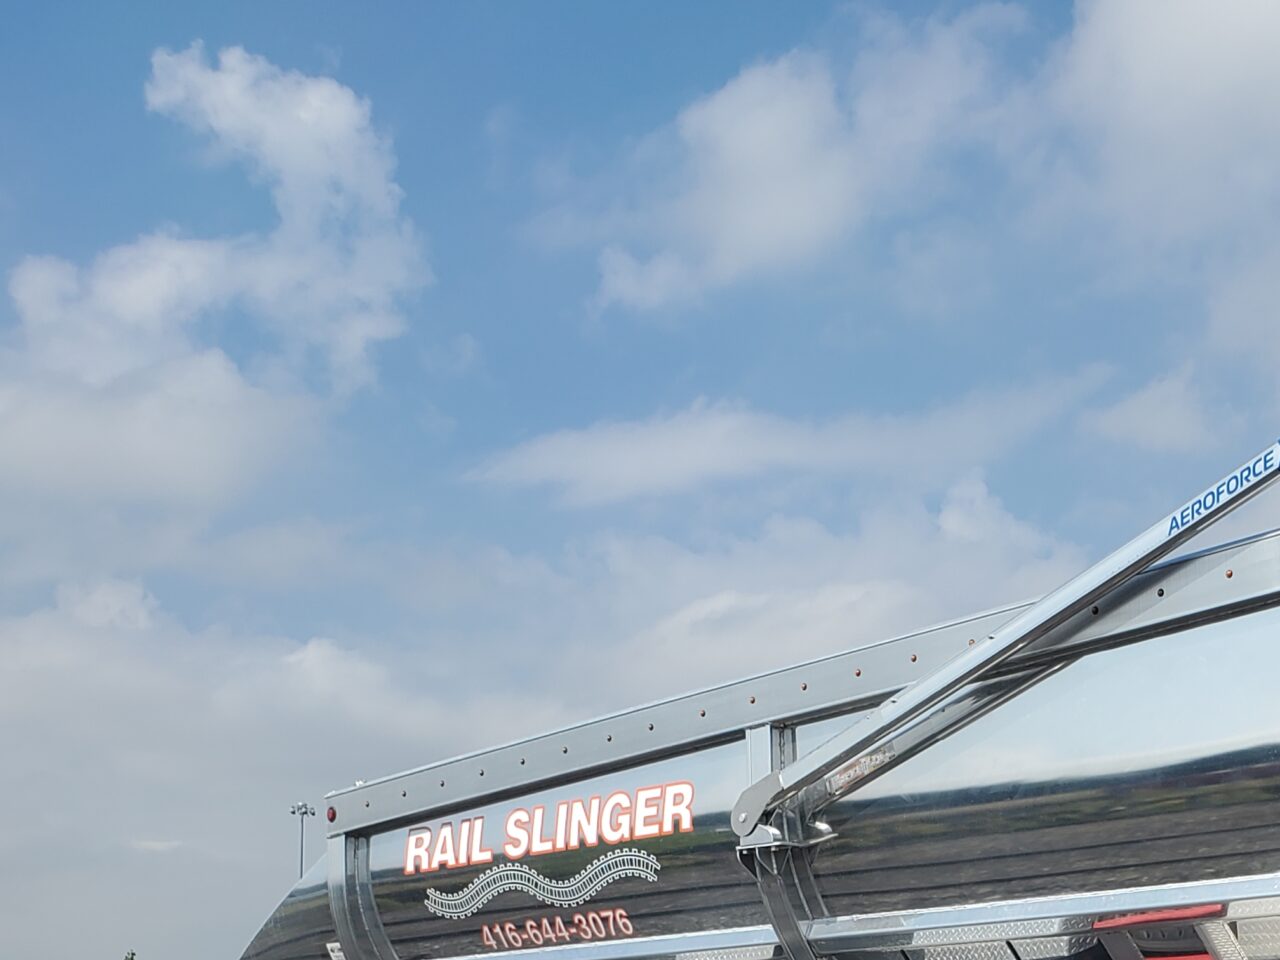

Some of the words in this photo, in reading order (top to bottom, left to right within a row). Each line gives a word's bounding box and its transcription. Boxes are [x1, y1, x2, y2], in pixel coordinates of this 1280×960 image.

[1167, 450, 1275, 536] AEROFORCE
[404, 815, 494, 875] RAIL
[504, 780, 695, 860] SLINGER
[481, 908, 634, 950] 416-644-3076
